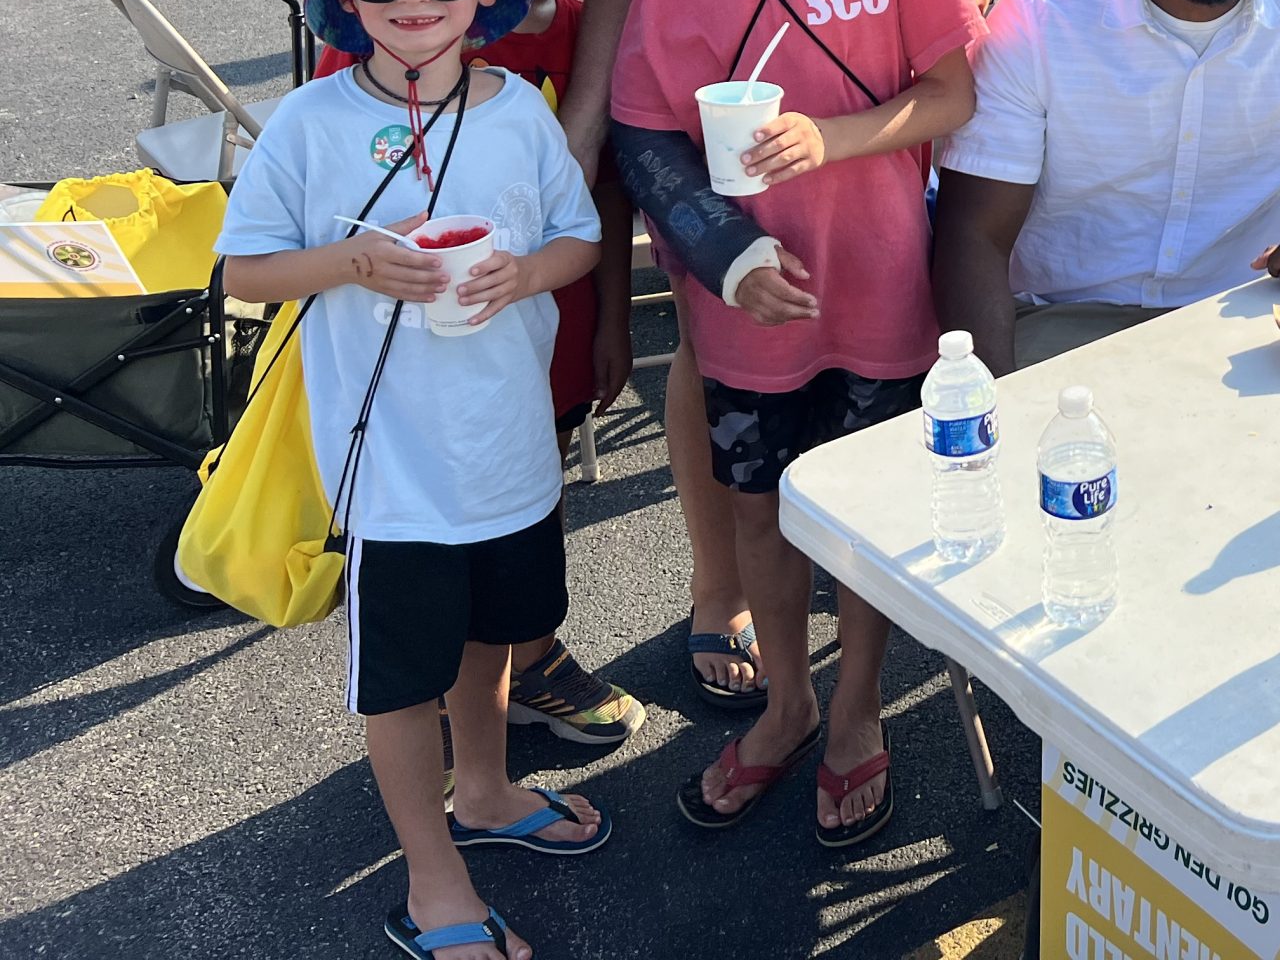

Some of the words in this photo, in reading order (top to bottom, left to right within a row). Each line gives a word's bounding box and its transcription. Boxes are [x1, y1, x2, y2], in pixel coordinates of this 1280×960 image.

[1079, 476, 1108, 495] Pure
[1083, 488, 1106, 506] Life
[1063, 760, 1169, 851] GRIZZLIES
